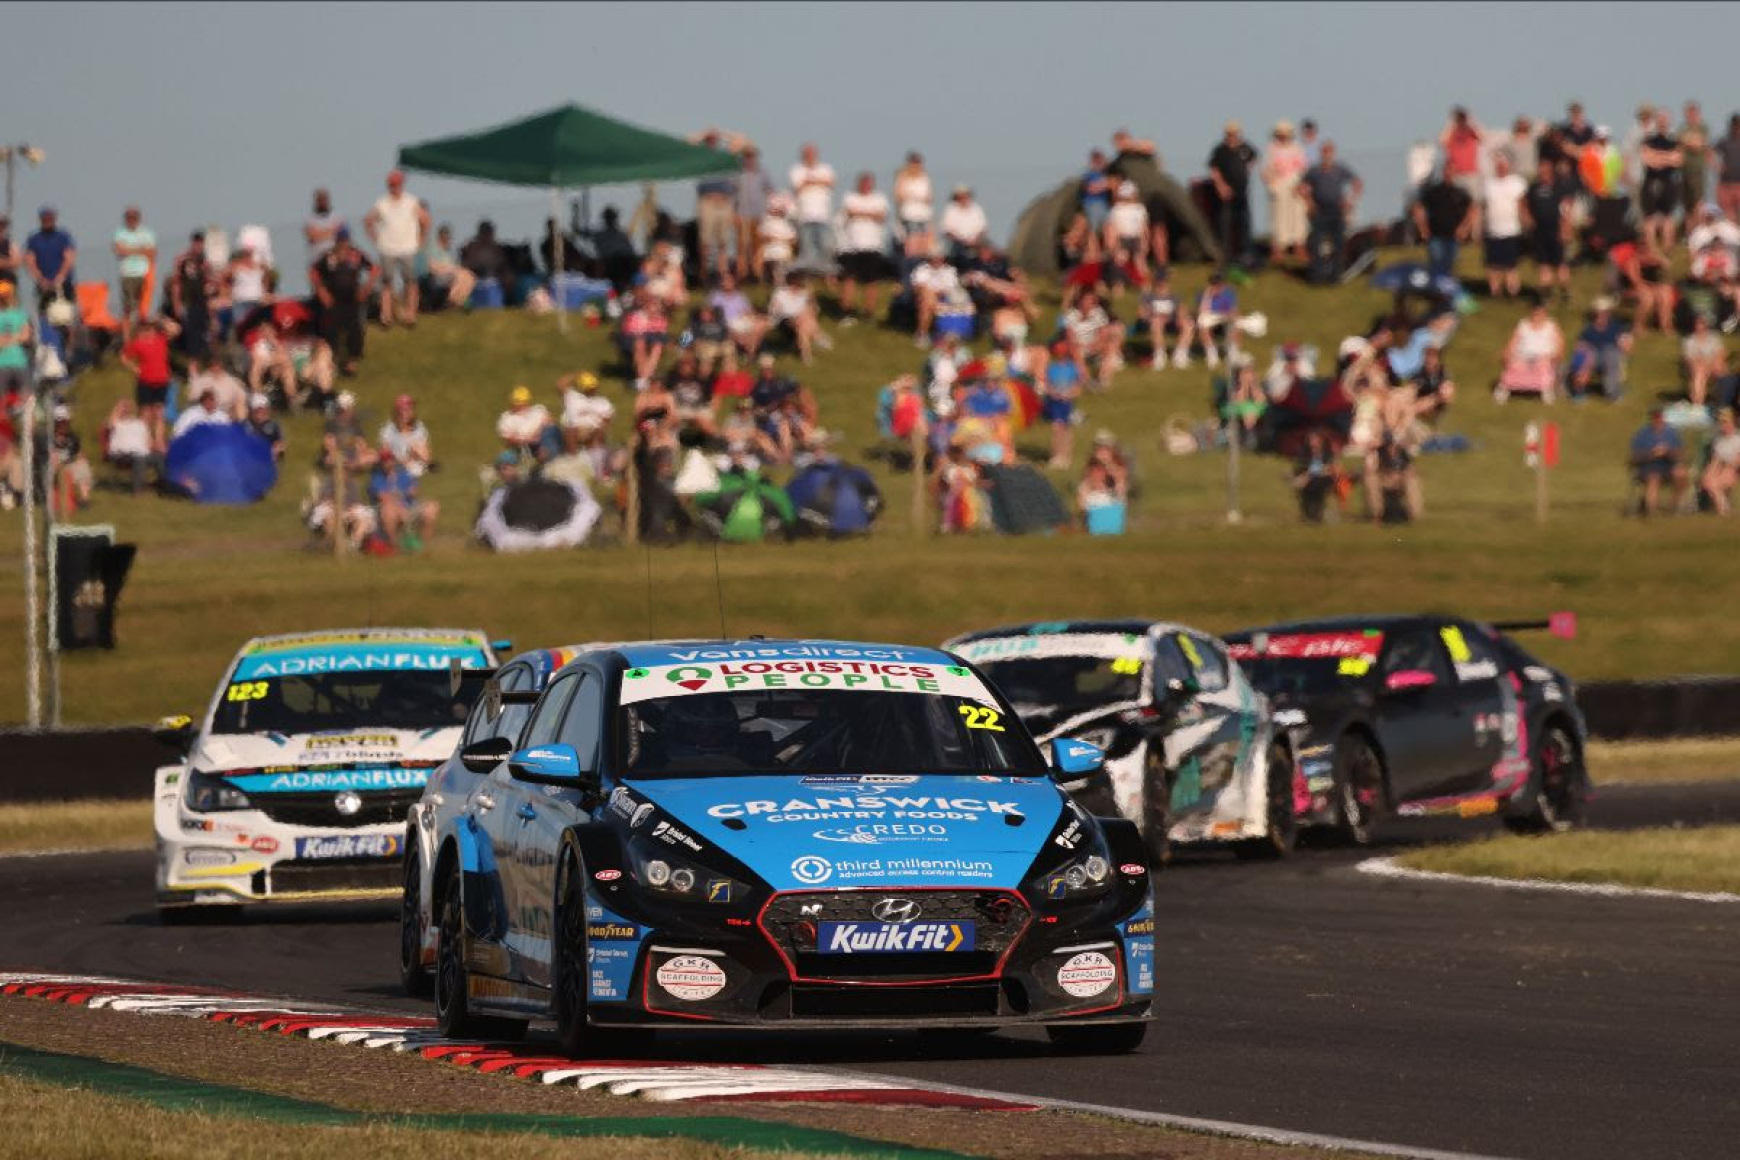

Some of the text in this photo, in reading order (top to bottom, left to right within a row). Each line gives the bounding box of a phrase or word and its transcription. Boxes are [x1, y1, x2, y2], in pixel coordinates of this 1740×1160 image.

[719, 661, 935, 679] LOGISTICS
[726, 674, 941, 692] PEOPLE
[228, 682, 269, 701] 123
[959, 705, 1005, 732] 22
[707, 797, 1026, 818] CRANSWICK
[767, 811, 979, 822] COUNTRY FOODS
[855, 824, 947, 835] CREDO
[835, 858, 993, 871] third millennium
[839, 869, 884, 878] advanced
[660, 973, 723, 982] SCAFFOLDING
[1061, 969, 1113, 980] SCAFFOLDING
